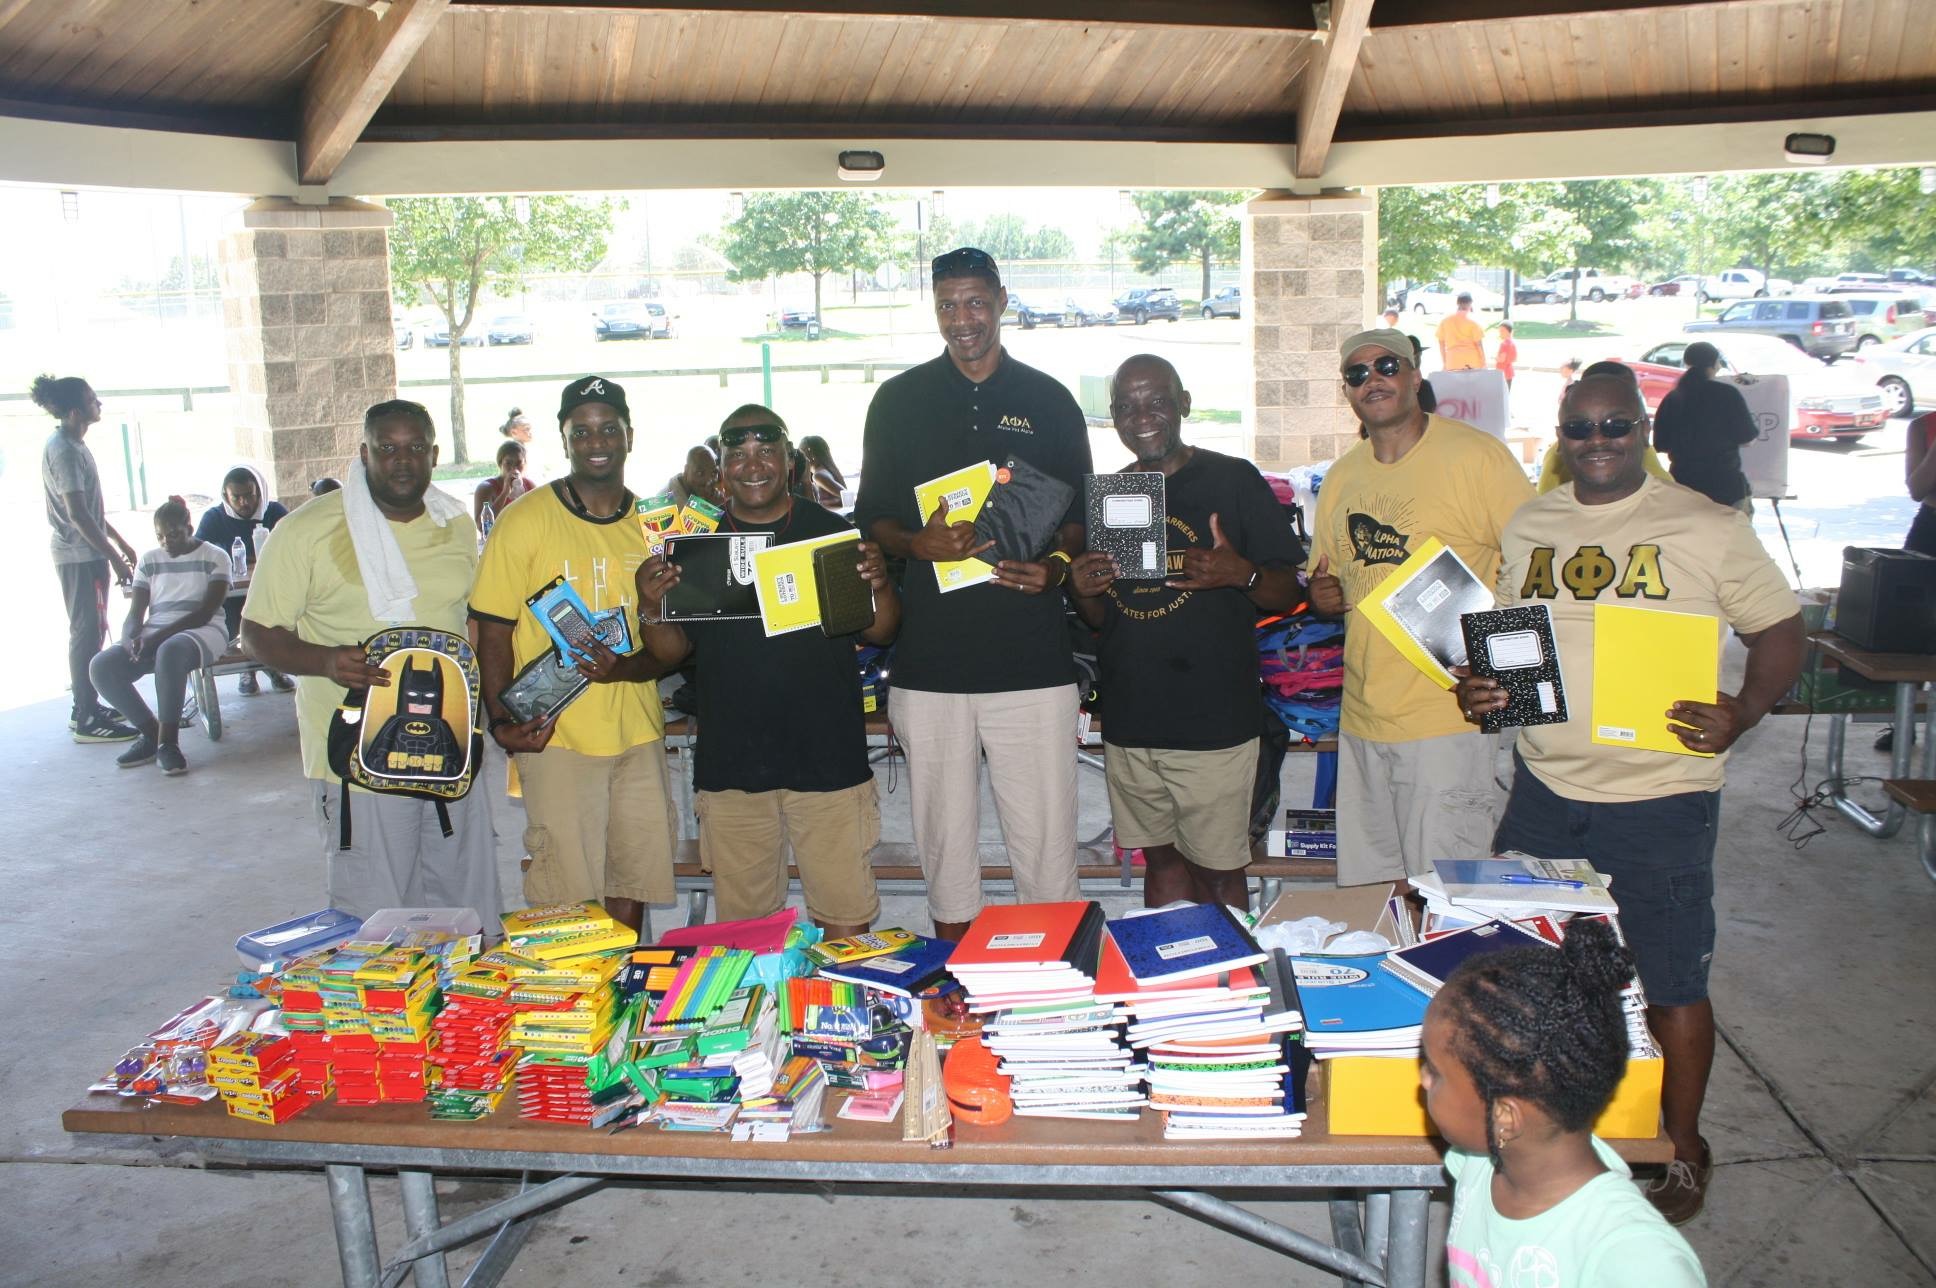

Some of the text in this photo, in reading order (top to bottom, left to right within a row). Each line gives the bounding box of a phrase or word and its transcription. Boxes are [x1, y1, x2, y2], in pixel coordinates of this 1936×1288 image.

[580, 379, 605, 395] A
[638, 504, 647, 512] 12
[689, 500, 698, 509] 12
[646, 512, 672, 523] Crayola
[687, 513, 711, 528] Crayola
[1165, 515, 1199, 544] ARRIERS
[1365, 546, 1405, 560] NATION
[1166, 554, 1184, 571] AW
[1520, 544, 1671, 601] ΑΦΑ
[1106, 587, 1193, 619] ADOATES FOR JUST
[1300, 842, 1319, 850] Supply
[554, 927, 610, 943] Crayola
[633, 970, 641, 980] 20
[700, 1026, 741, 1037] DIXON
